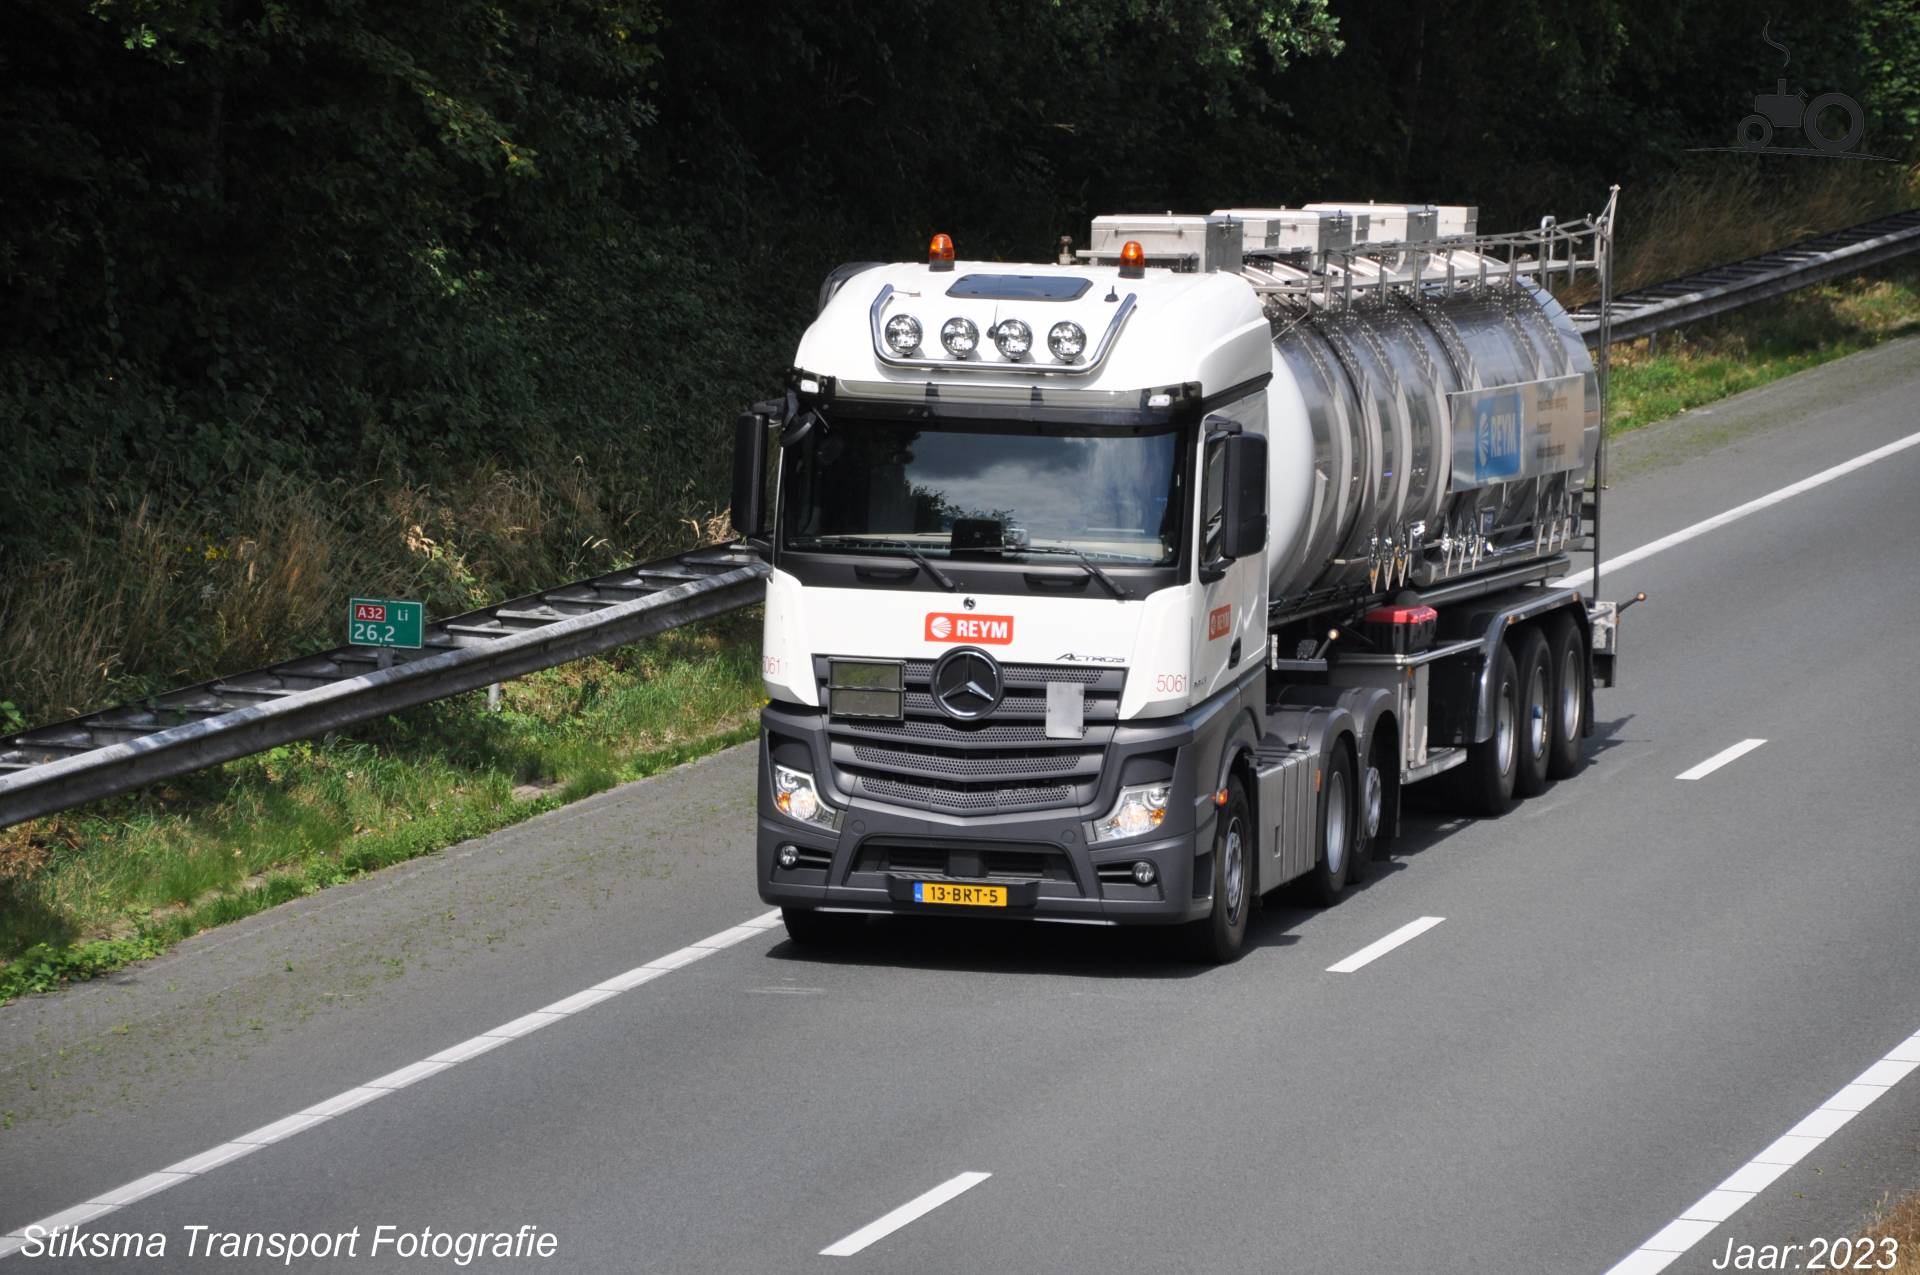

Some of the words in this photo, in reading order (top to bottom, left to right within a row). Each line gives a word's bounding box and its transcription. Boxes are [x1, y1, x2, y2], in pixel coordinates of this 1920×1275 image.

[357, 606, 383, 620] A32
[398, 609, 408, 621] Li
[354, 623, 395, 643] 26,2
[956, 619, 1008, 639] REYM
[1157, 674, 1188, 693] 5061
[931, 886, 998, 903] 13-BRT-5
